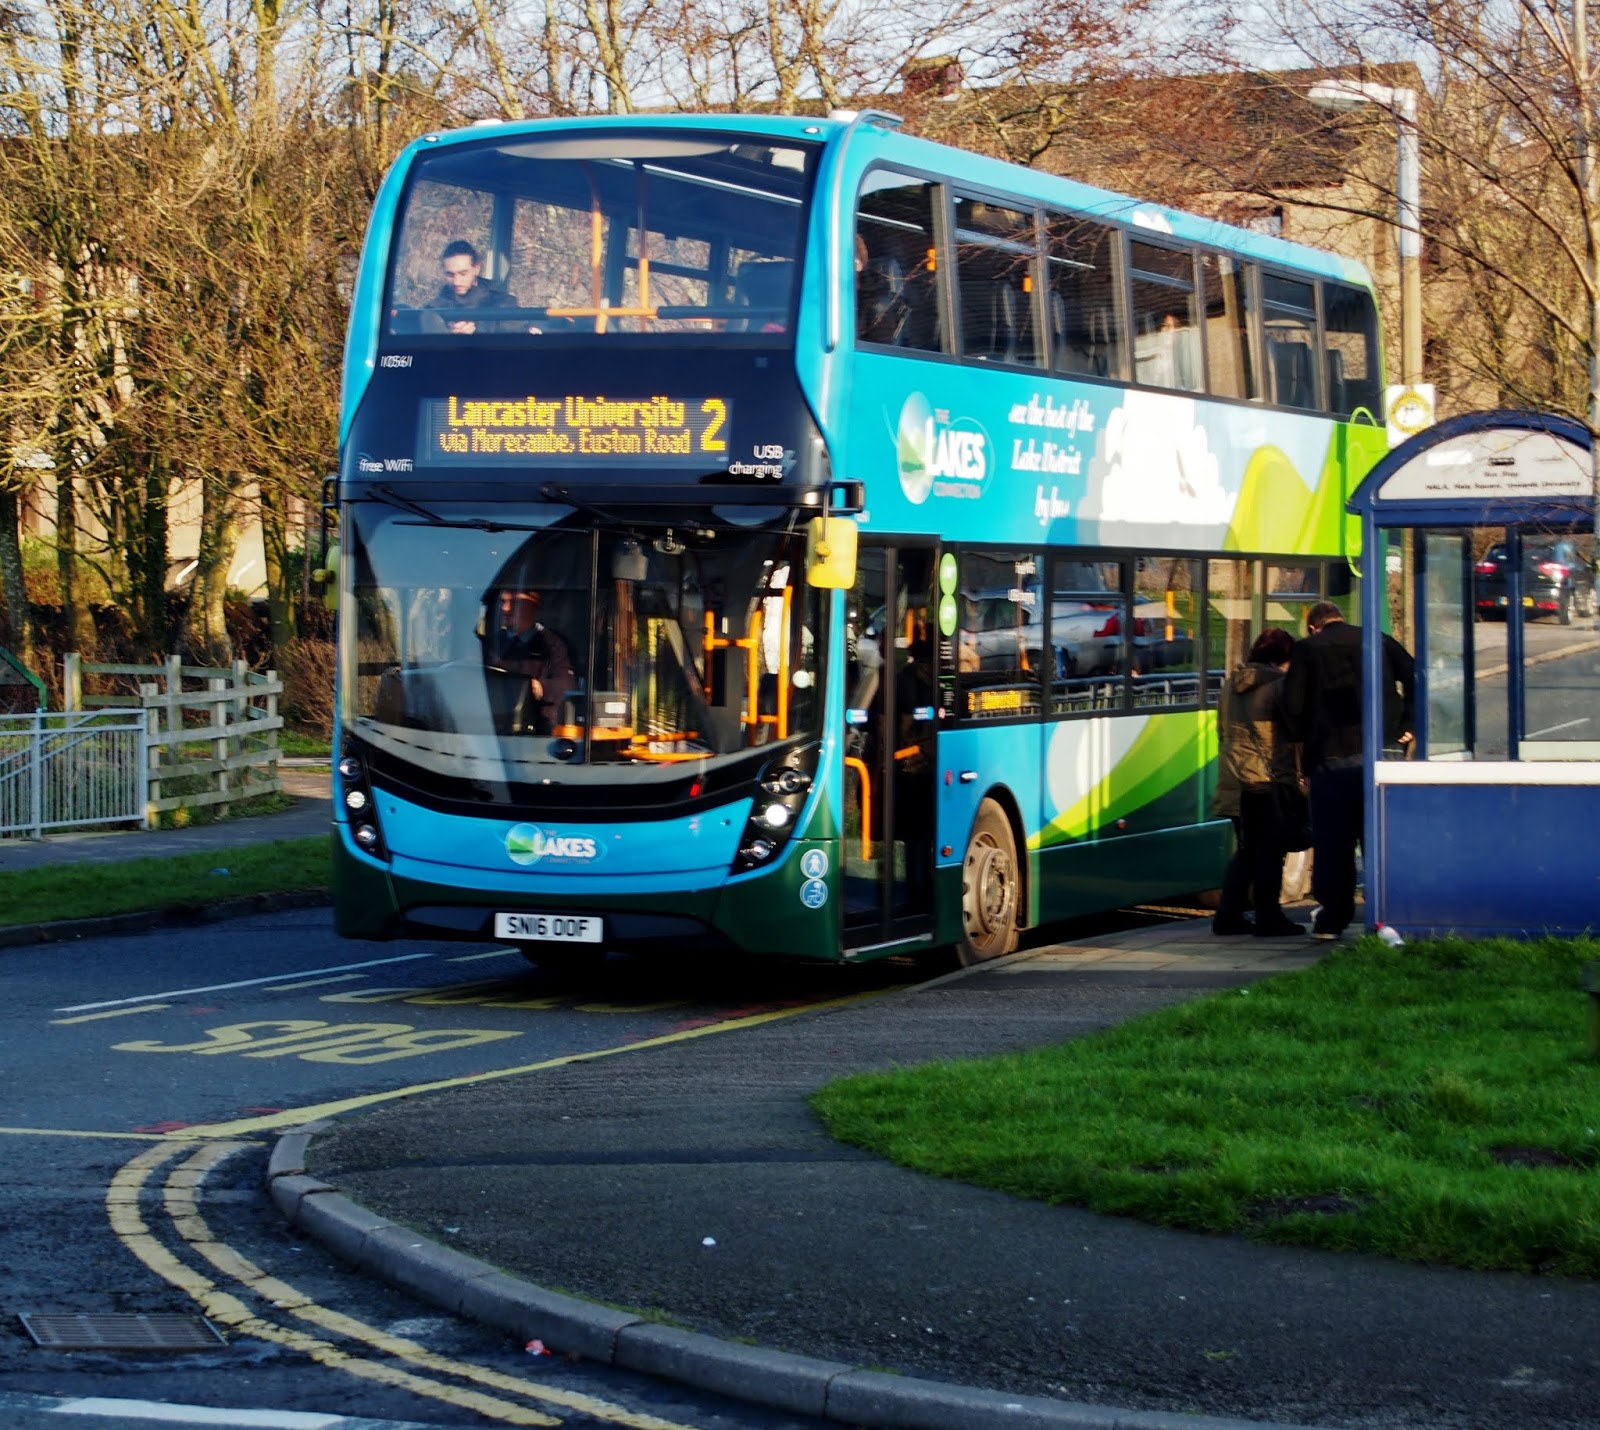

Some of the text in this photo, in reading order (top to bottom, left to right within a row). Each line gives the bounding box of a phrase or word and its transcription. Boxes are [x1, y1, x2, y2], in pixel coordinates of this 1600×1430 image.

[448, 396, 685, 427] Lancaster University
[700, 398, 727, 451] 2
[440, 428, 468, 453] via
[578, 428, 642, 453] Euston
[644, 428, 692, 453] Road
[753, 445, 784, 459] USB
[925, 415, 986, 481] LAKES
[359, 459, 384, 472] free
[1010, 438, 1042, 472] Lake
[728, 461, 783, 479] charging
[534, 832, 597, 858] LAKES
[507, 916, 547, 936] SN16
[110, 1019, 526, 1065] BUS
